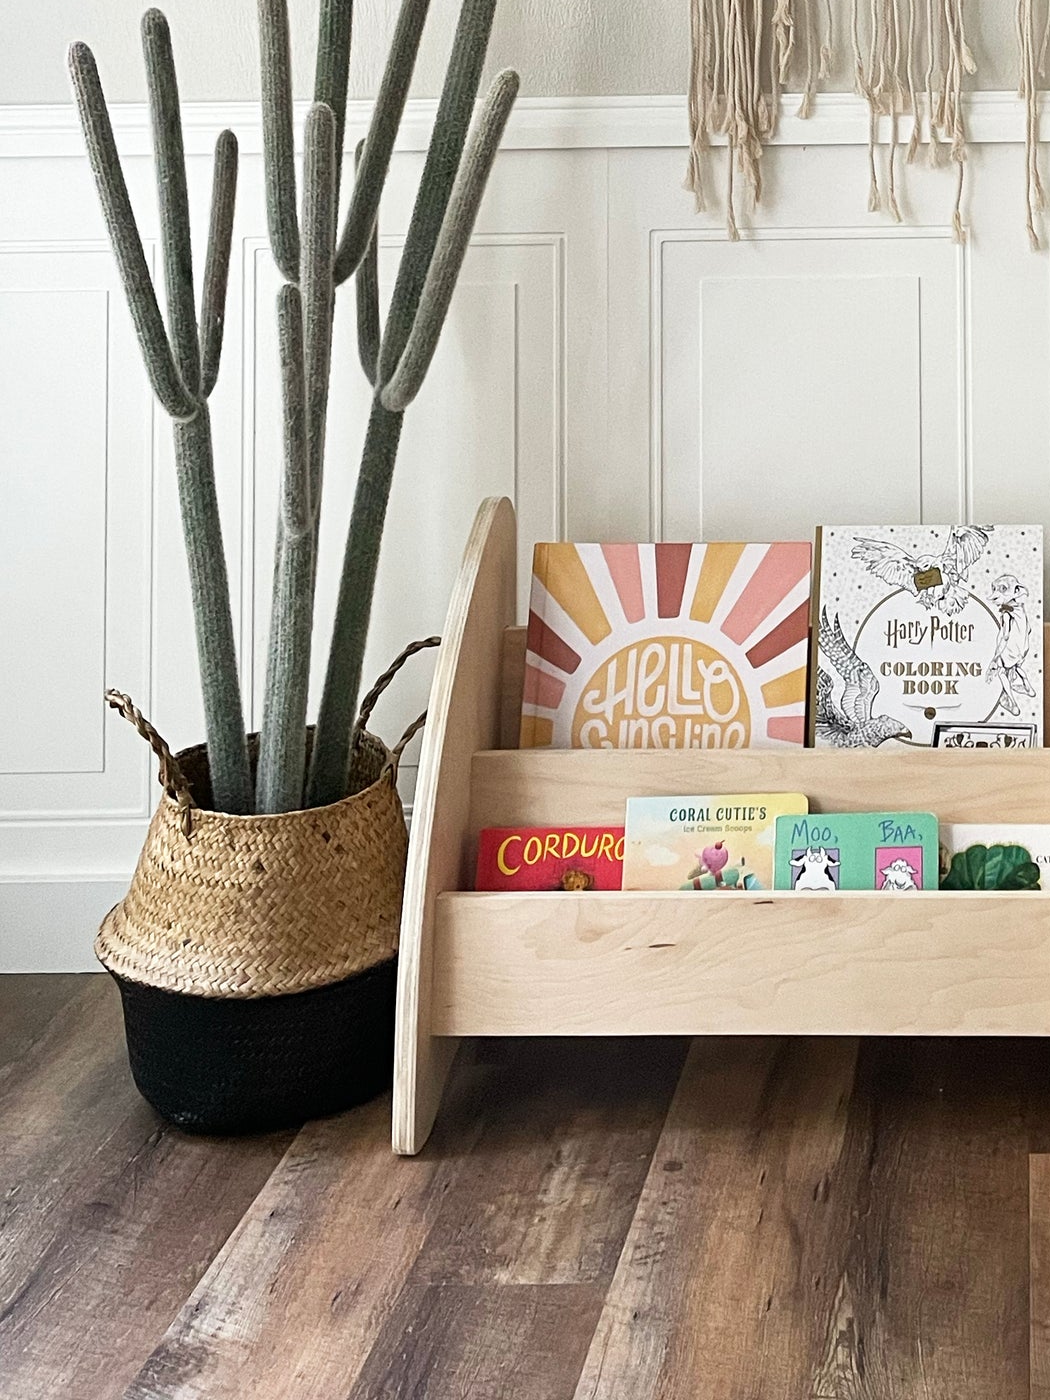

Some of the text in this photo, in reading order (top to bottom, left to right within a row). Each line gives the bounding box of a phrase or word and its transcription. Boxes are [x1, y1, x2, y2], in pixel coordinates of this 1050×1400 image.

[884, 616, 975, 649] Harry Potter
[880, 661, 982, 677] COLORING
[902, 680, 959, 695] BOOK
[669, 806, 767, 822] CORAL CUTIE'S
[697, 825, 723, 833] Cream
[725, 824, 753, 833] Scoops
